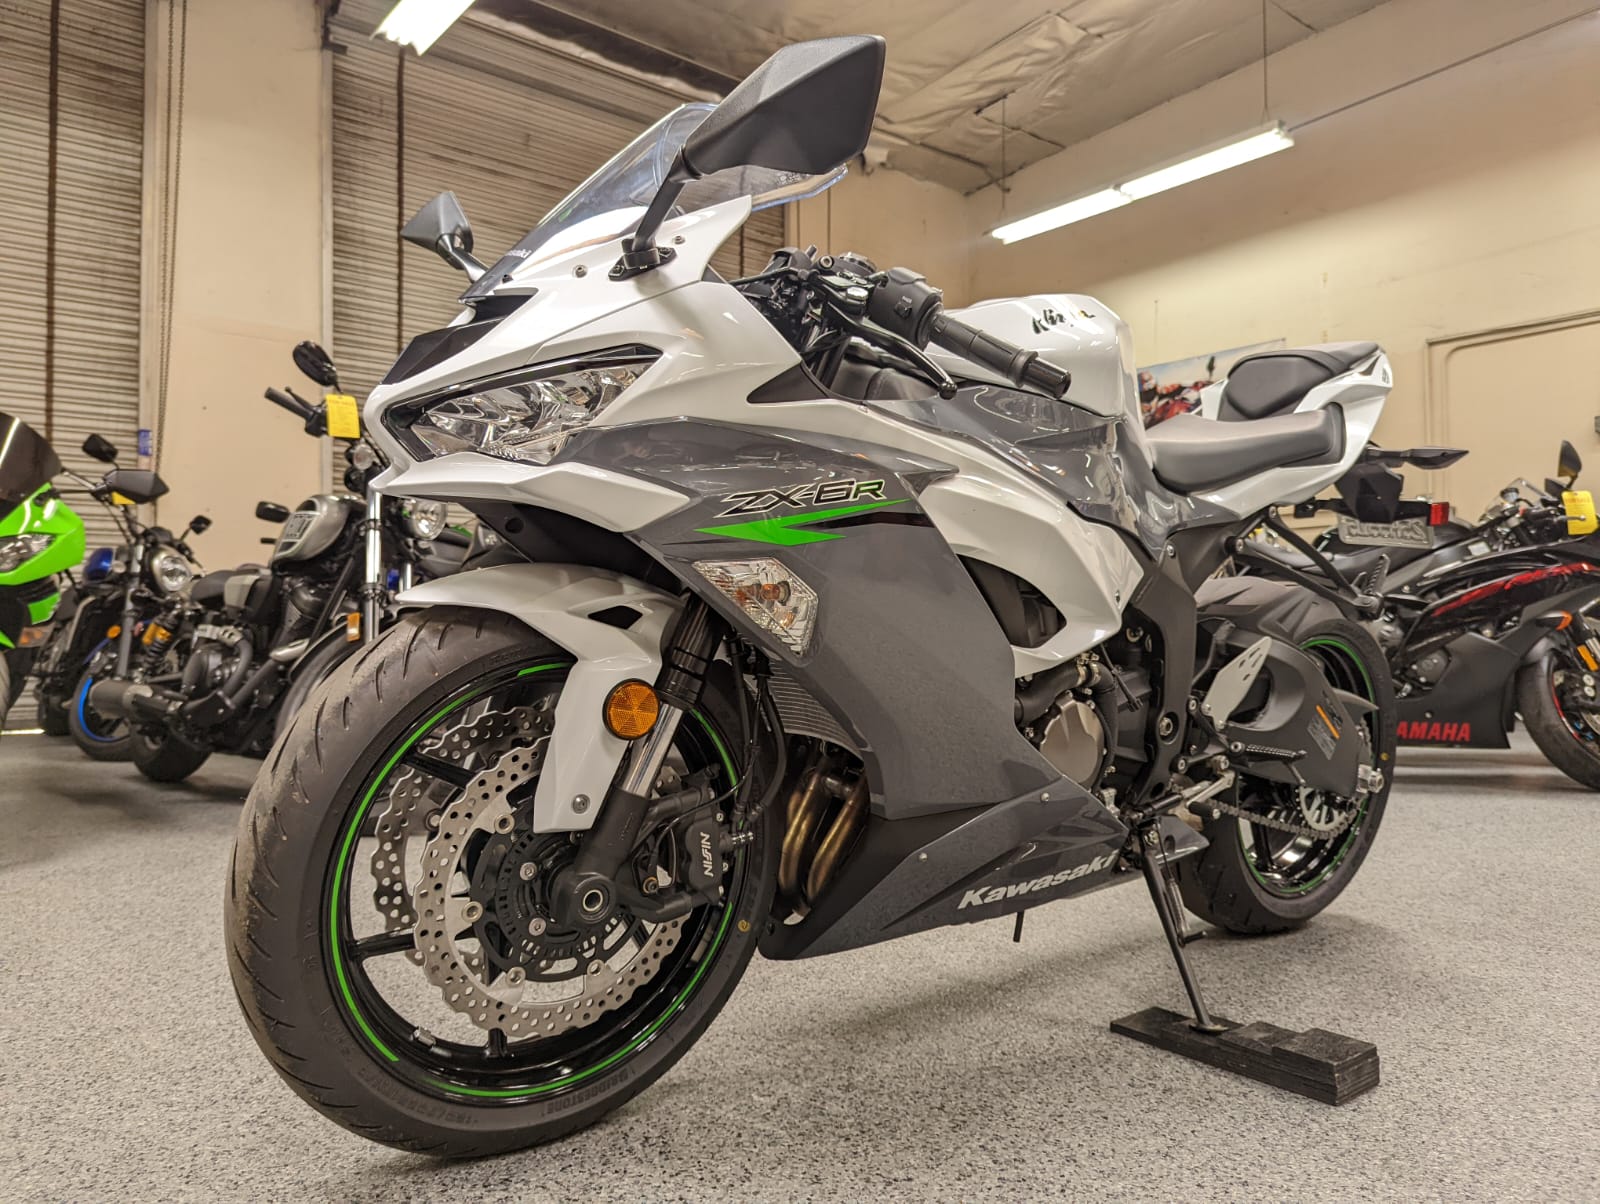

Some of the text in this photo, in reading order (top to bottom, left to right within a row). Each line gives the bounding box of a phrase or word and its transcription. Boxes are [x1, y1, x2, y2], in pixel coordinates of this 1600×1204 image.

[713, 478, 887, 518] ZX-6R
[1396, 720, 1471, 742] AMAHA
[957, 849, 1120, 910] Kawasaki
